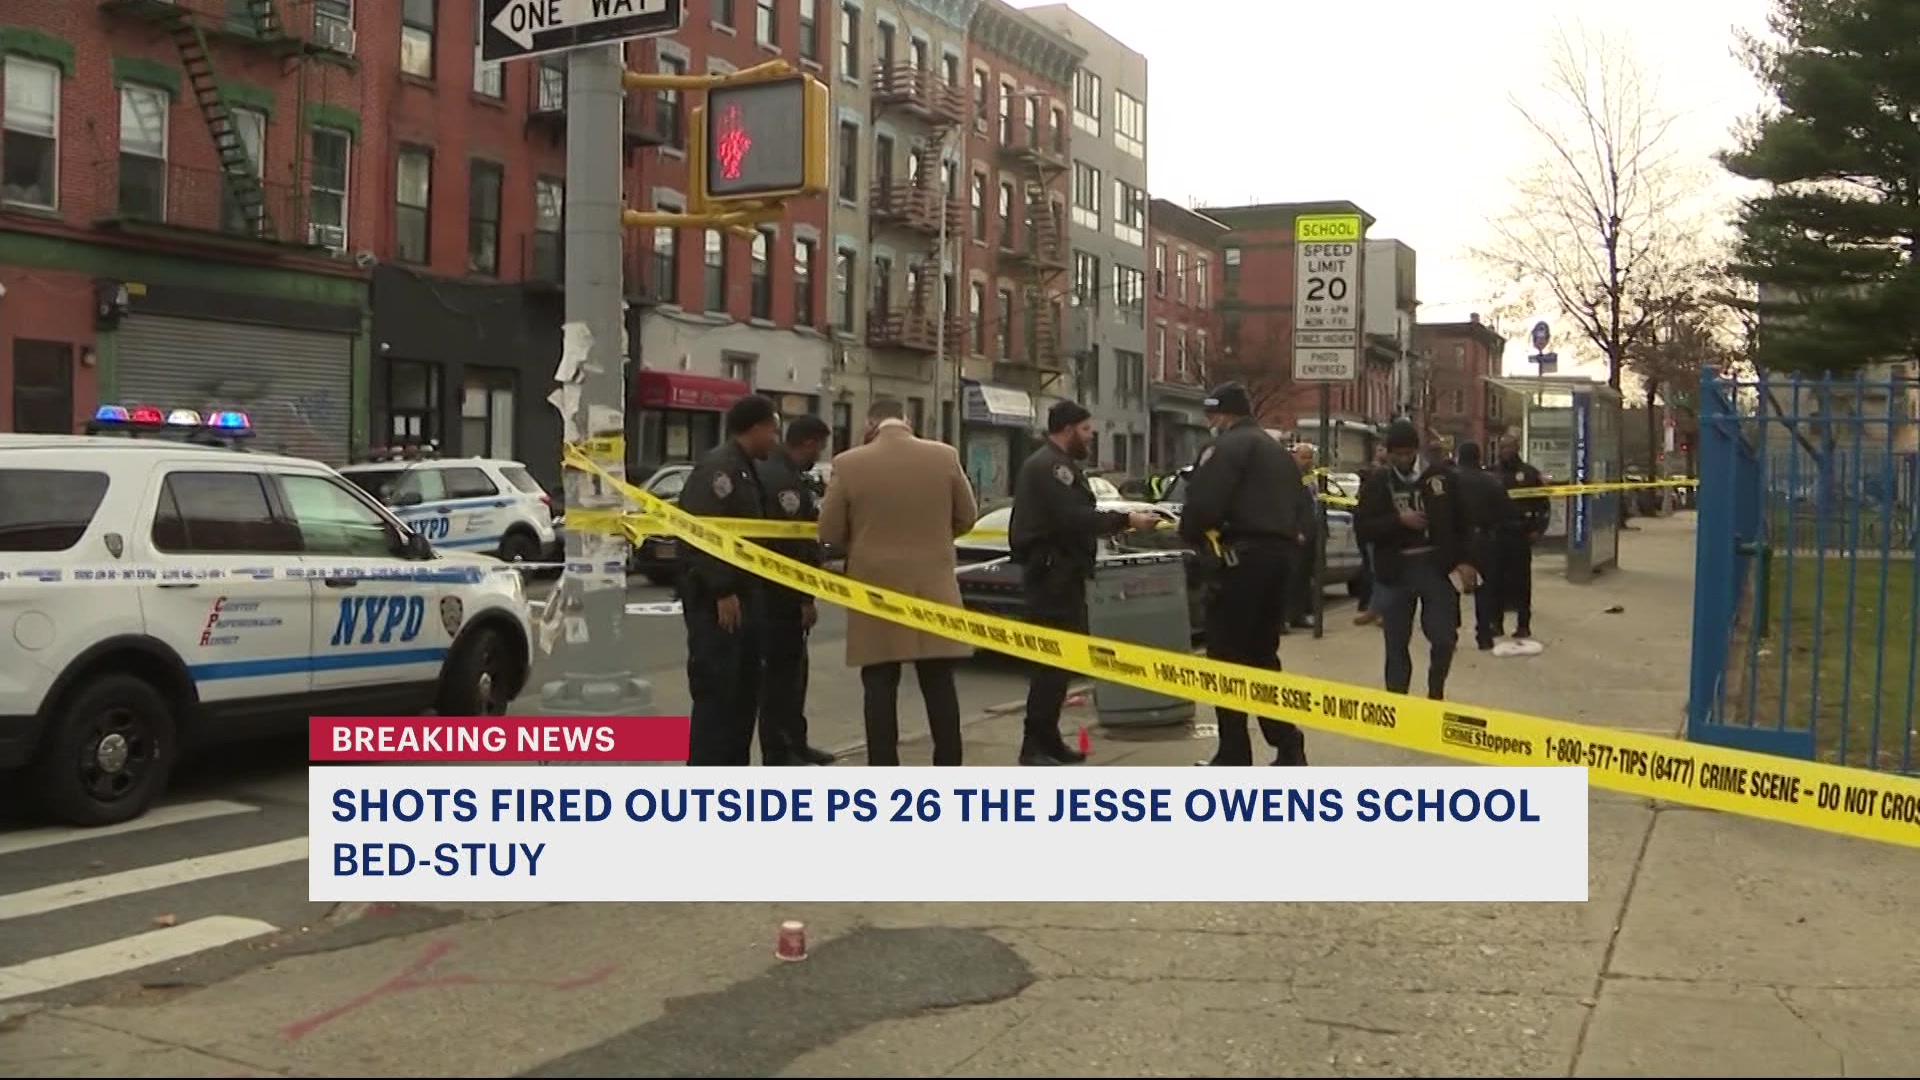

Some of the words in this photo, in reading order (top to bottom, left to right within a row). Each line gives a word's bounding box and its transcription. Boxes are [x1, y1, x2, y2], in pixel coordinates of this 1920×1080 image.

[511, 0, 563, 33] ONE
[1303, 222, 1354, 236] SCHOOL
[1304, 244, 1352, 257] SPEED
[1308, 260, 1346, 273] LIMIT
[1307, 276, 1347, 300] 20
[330, 595, 425, 645] NYPD
[1250, 681, 1279, 705] CRIME
[1282, 686, 1312, 712] SCENE
[1323, 694, 1337, 717] DO
[1339, 698, 1359, 721] NOT
[1361, 701, 1396, 729] CROSS
[1545, 736, 1648, 777] 1-800-577-TIPS
[1650, 751, 1695, 788] (8477)
[1700, 762, 1748, 794] CRIME
[1750, 769, 1801, 804] SCENE
[1818, 782, 1841, 811] DO
[1844, 786, 1878, 817] NOT
